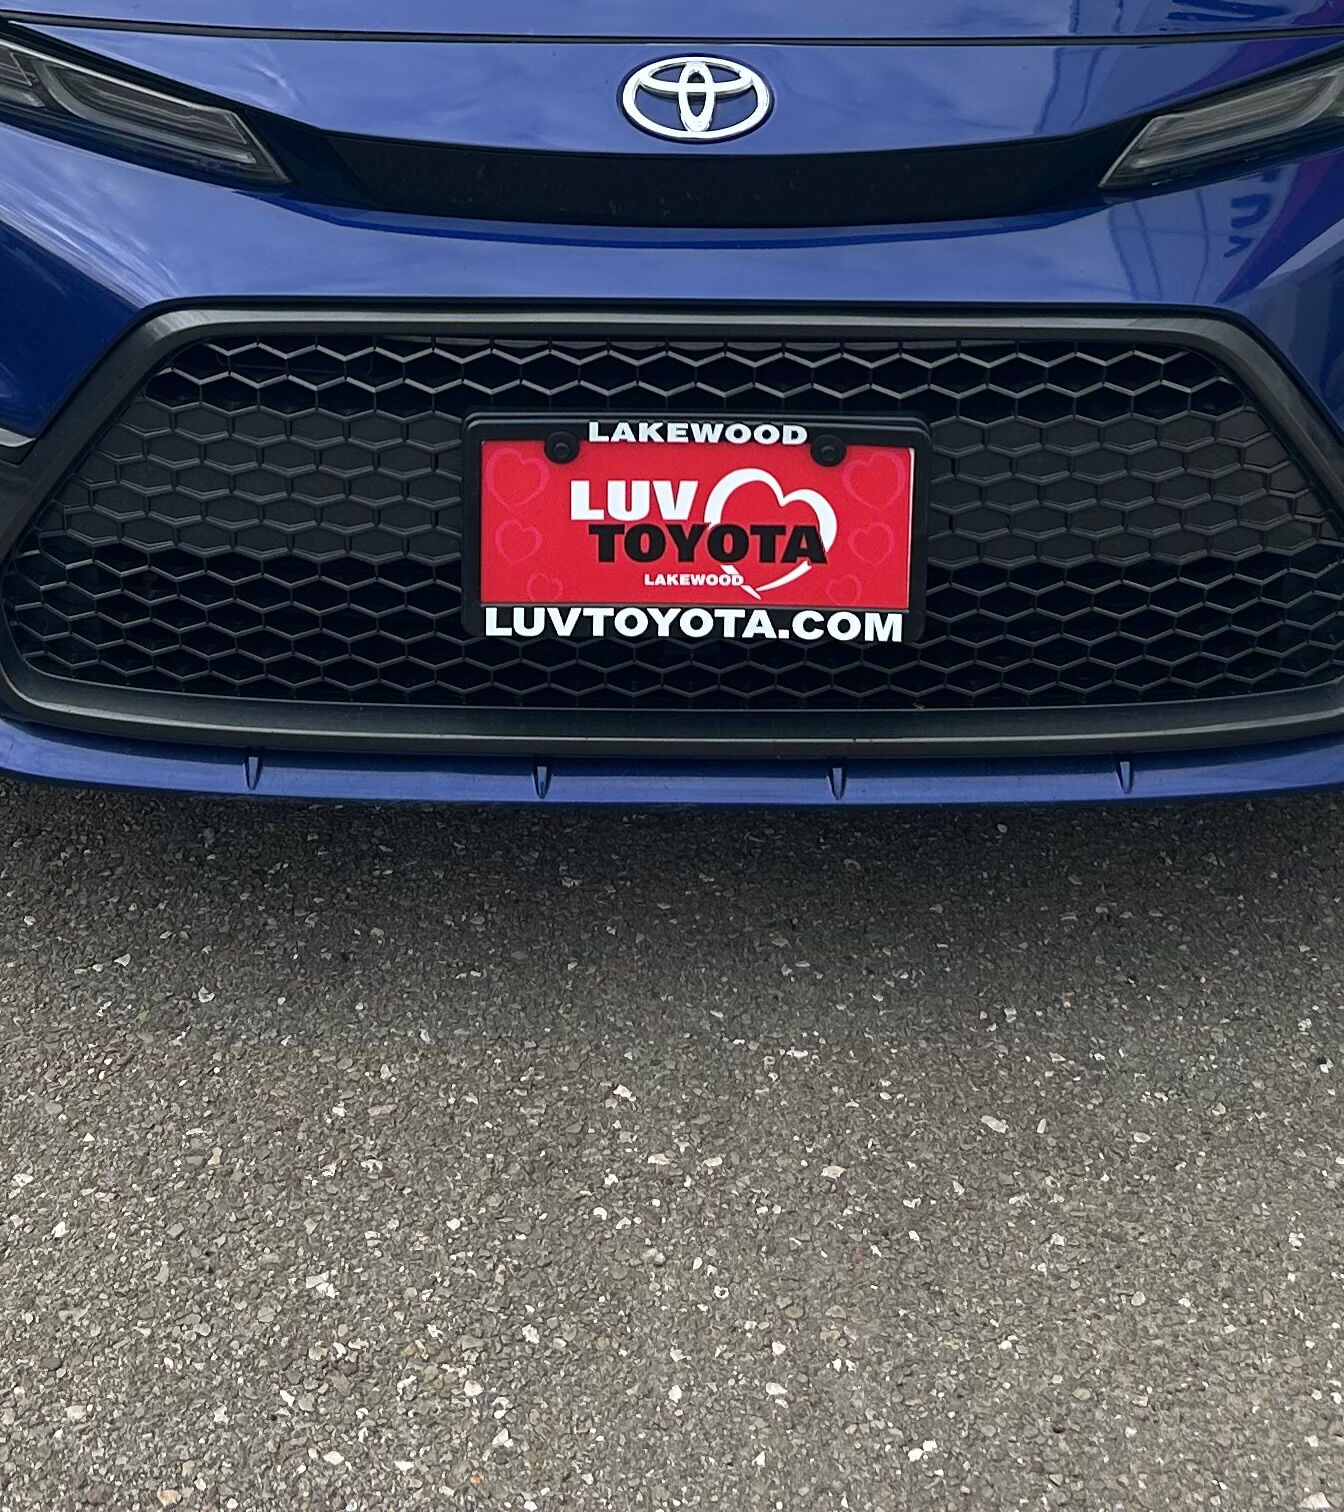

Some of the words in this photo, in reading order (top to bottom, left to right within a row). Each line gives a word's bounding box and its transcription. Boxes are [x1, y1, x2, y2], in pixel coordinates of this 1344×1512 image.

[588, 421, 808, 446] LAKEWOOD
[569, 479, 698, 522] LUV
[588, 523, 829, 565] TOYOTA
[644, 572, 745, 587] LAKEWOOD
[485, 607, 904, 643] LUVTOYOTA.COM
